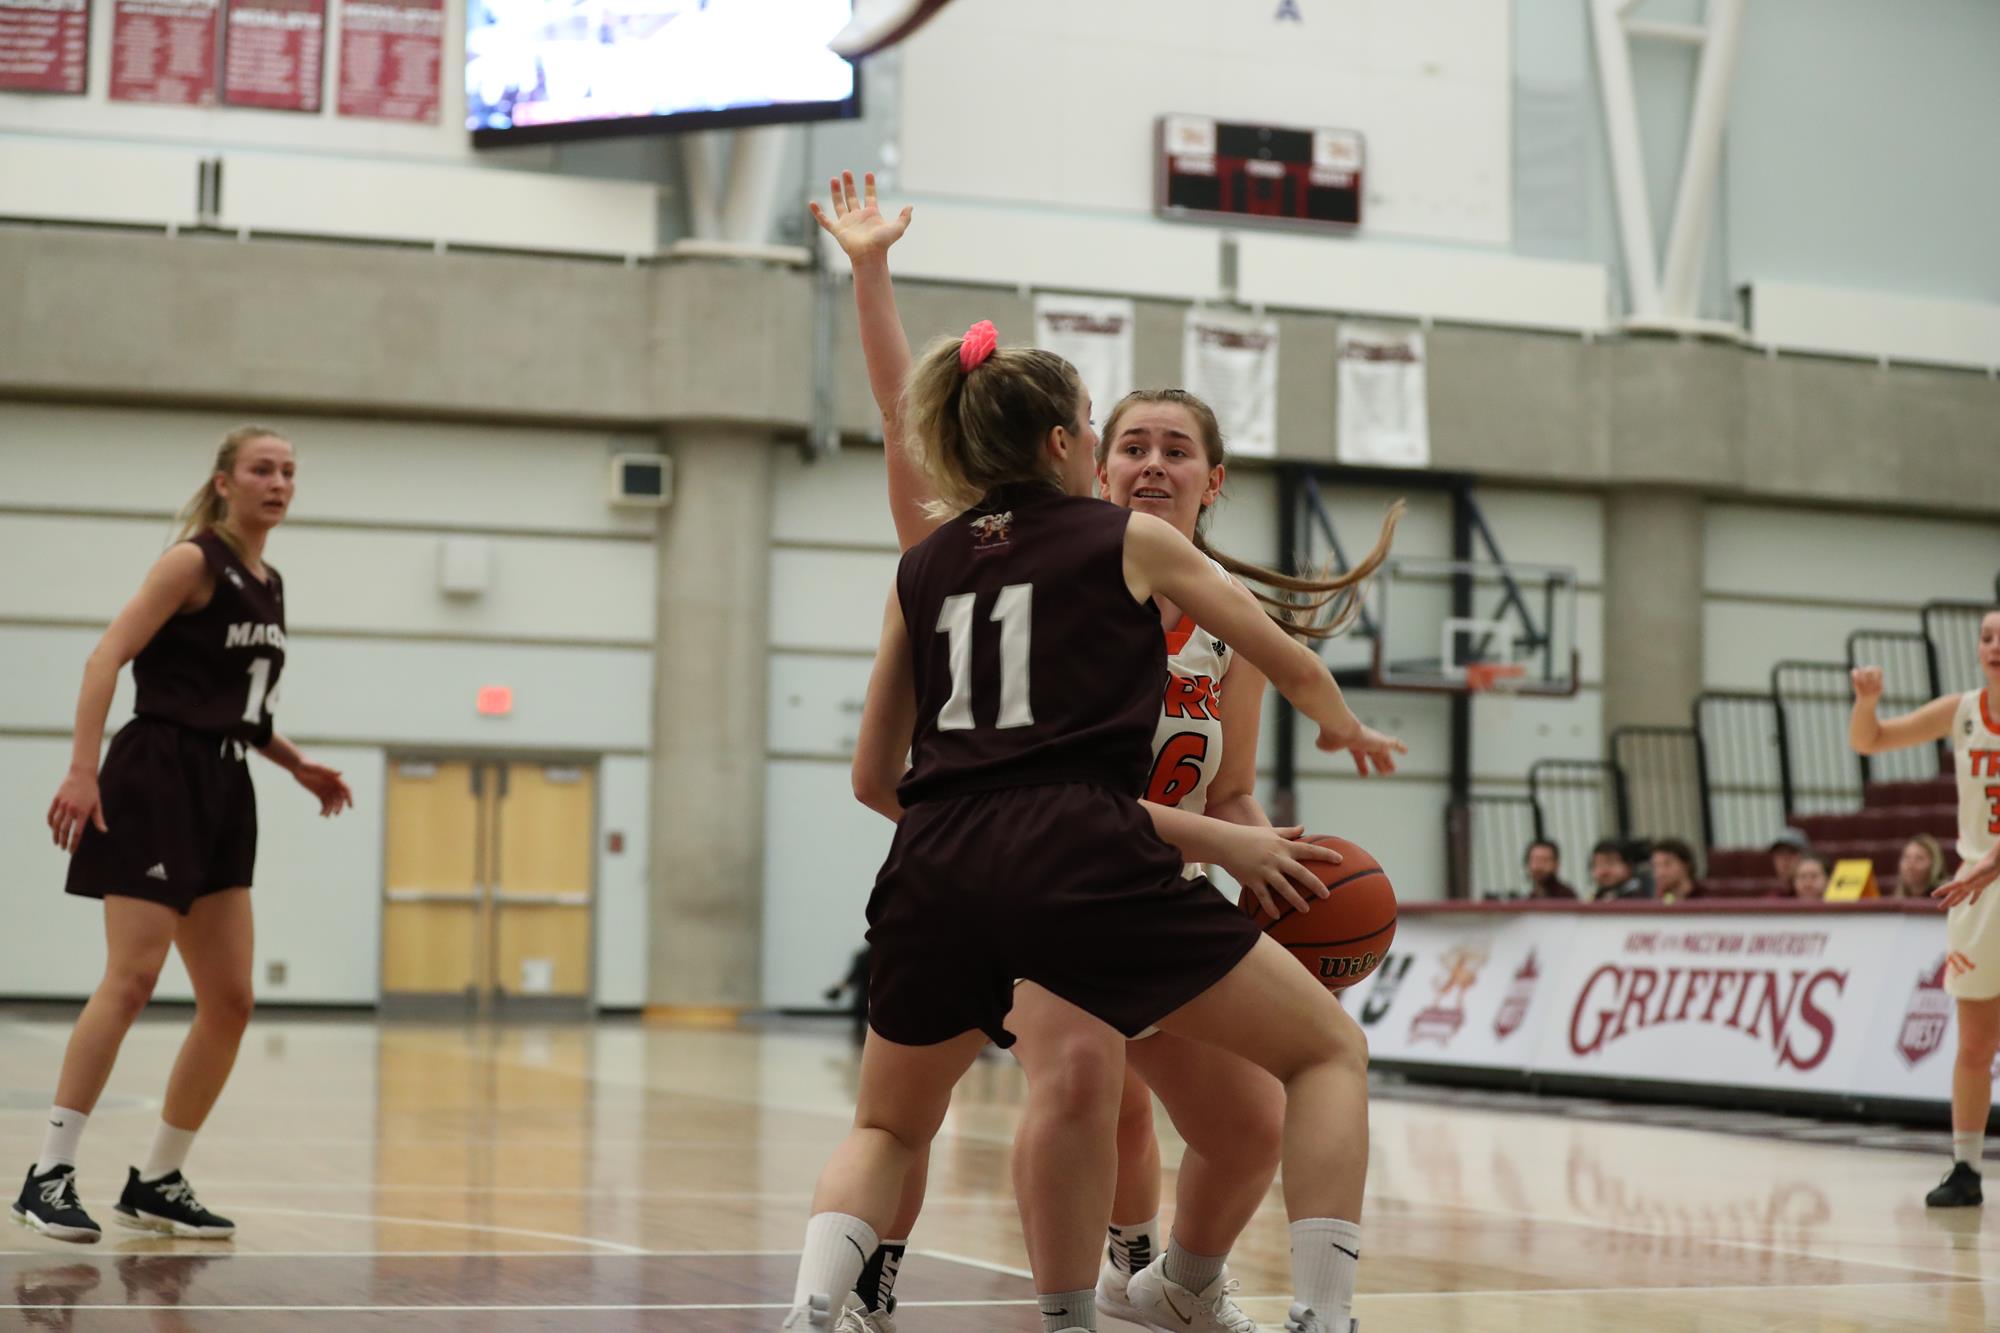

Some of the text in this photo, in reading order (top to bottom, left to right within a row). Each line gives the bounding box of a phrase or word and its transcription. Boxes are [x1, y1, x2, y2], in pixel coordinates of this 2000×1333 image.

[935, 583, 1034, 732] 11
[1143, 731, 1209, 807] 6
[1569, 965, 1848, 1072] GRIFFINS
